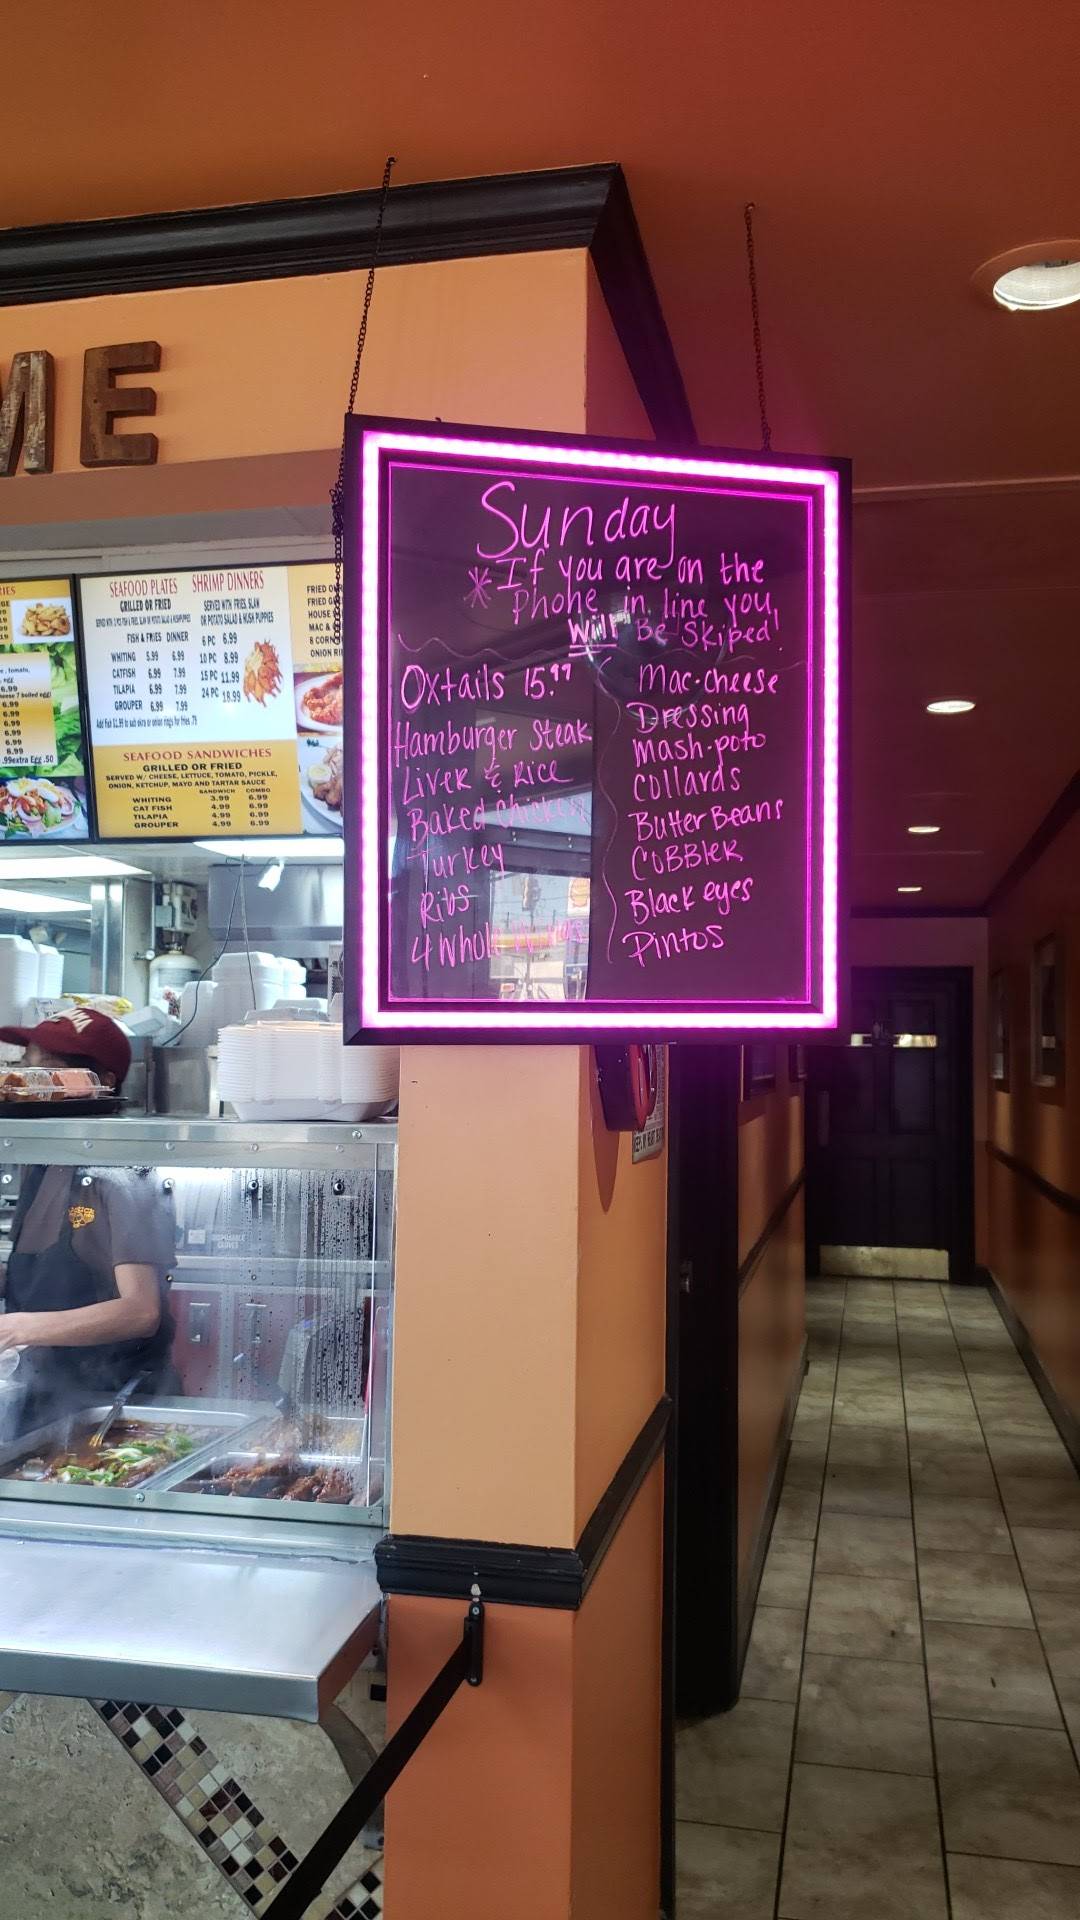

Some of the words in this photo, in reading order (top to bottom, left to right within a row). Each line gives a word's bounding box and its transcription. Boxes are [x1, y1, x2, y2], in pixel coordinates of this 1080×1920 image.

[477, 481, 675, 568] Sunday
[496, 549, 545, 589] If
[559, 555, 602, 594] you
[615, 556, 662, 580] are
[678, 556, 704, 584] on
[721, 552, 764, 585] the
[110, 580, 148, 598] SEAFOOD
[150, 578, 178, 595] PLATES
[192, 573, 224, 593] SHRIMP
[227, 570, 264, 591] DINNERS
[306, 585, 327, 594] FRIED
[120, 600, 143, 612] GRILLED
[145, 599, 153, 611] OR
[154, 598, 171, 610] FRIED
[307, 598, 327, 606] FRIED
[624, 586, 646, 614] in
[664, 588, 708, 619] line
[208, 614, 224, 626] POTATO
[224, 613, 238, 625] SALAD
[308, 610, 331, 618] HOUSE
[309, 623, 324, 631] MAC
[127, 633, 139, 643] FISH
[146, 632, 162, 643] FRIES
[166, 631, 189, 642] DINNER
[202, 636, 206, 646] 6
[208, 635, 216, 646] PC
[222, 631, 238, 645] 6.99
[111, 651, 136, 662] WHITING
[200, 653, 207, 664] 10
[209, 652, 217, 664] PC
[224, 652, 239, 664] 8.99
[310, 649, 332, 657] ONION
[112, 668, 136, 679] CATFISH
[148, 668, 161, 679] 6.99
[174, 667, 186, 678] 7.99
[201, 671, 208, 681] 15
[210, 670, 218, 681] PC
[221, 671, 240, 683] 11.99
[113, 684, 135, 695] TILAPIA
[149, 683, 162, 695] 6.99
[175, 684, 187, 695] 7.99
[202, 688, 209, 698] 24
[211, 687, 219, 698] PC
[401, 664, 505, 712] Oxtails
[115, 700, 143, 711] GROUPER
[150, 701, 163, 712] 6.99
[176, 700, 188, 711] 7.99
[626, 702, 749, 735] Dressing
[395, 721, 518, 767] Hamburger
[530, 718, 592, 751] Steak
[123, 751, 182, 761] SEAFOOD
[187, 748, 272, 759] SANDWICHES
[143, 764, 188, 772] GRILLED
[210, 762, 242, 770] FRIED
[408, 844, 504, 888] Turkey
[703, 877, 753, 915] eyes
[411, 934, 432, 971] 4
[622, 925, 724, 967] Pintos
